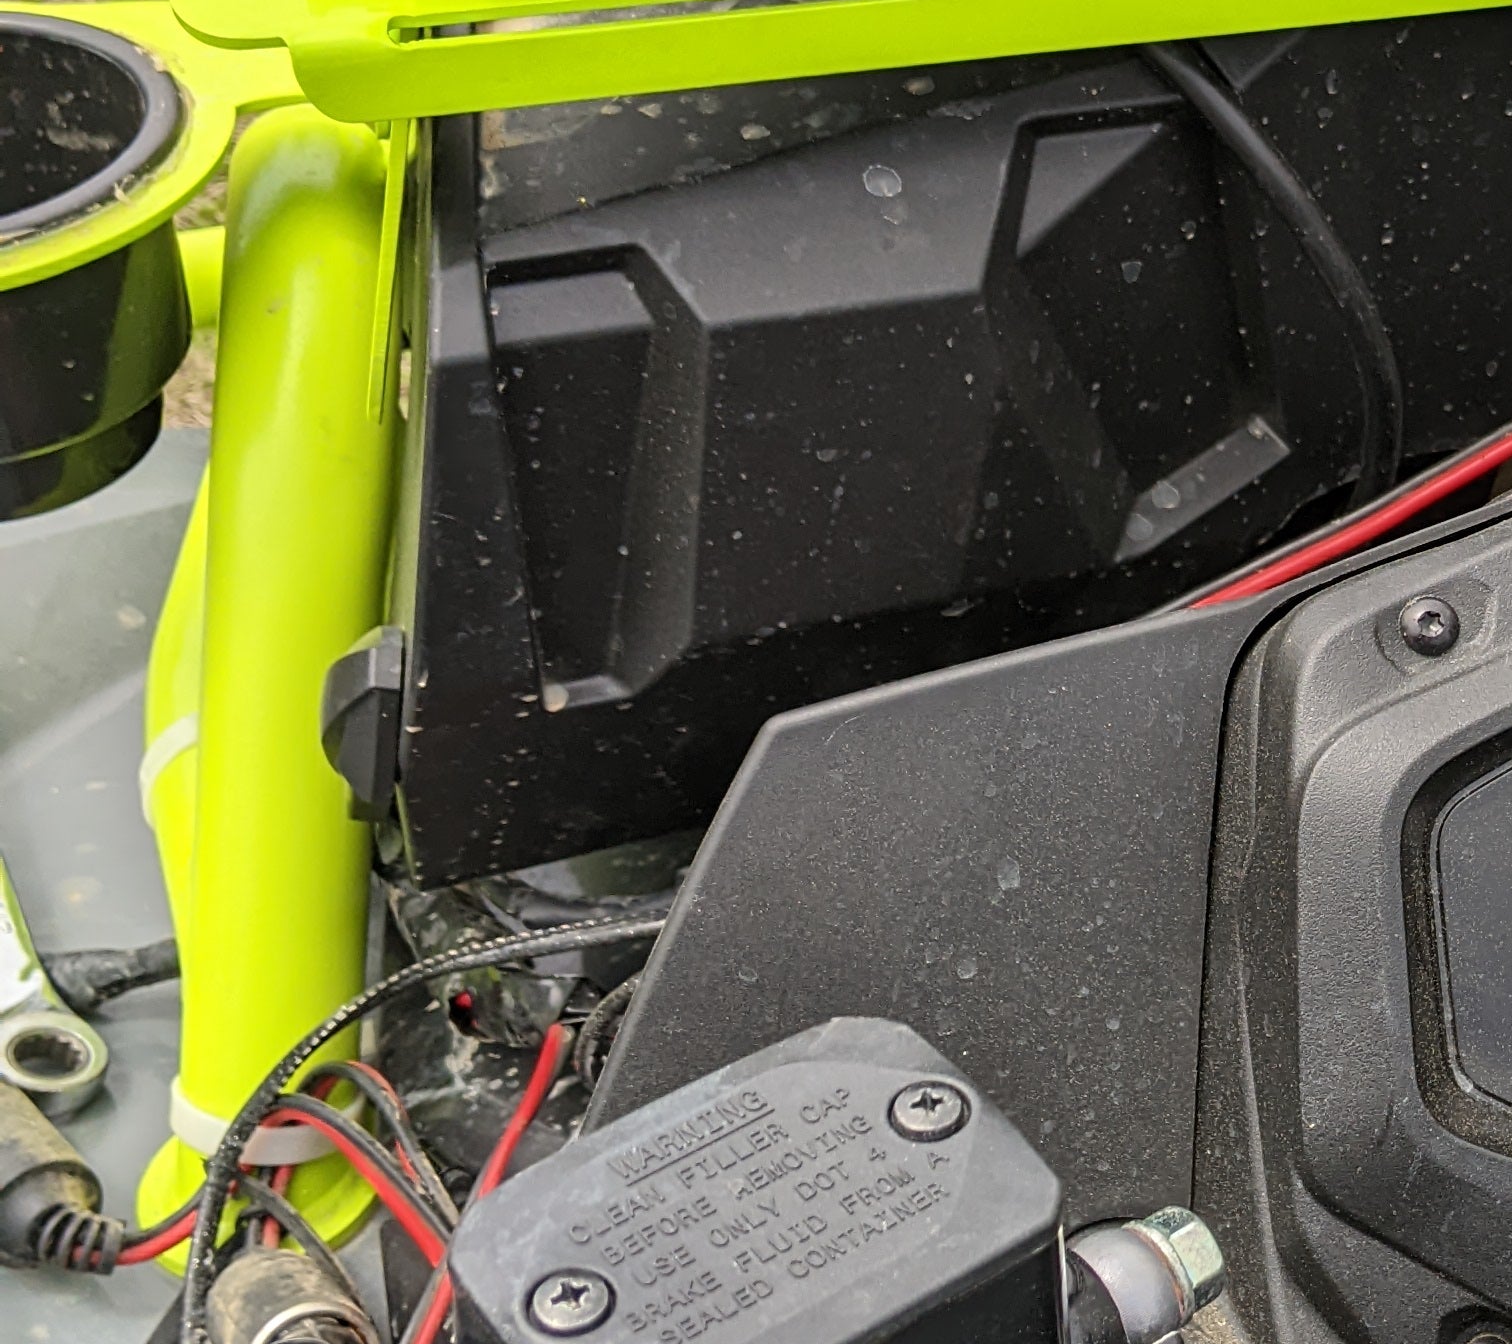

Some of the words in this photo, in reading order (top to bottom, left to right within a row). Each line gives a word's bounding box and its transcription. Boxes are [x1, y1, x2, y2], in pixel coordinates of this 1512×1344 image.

[568, 1185, 666, 1246] CLEAN
[681, 1121, 788, 1191] FILLER
[800, 1086, 853, 1128] CAP
[601, 1194, 718, 1267] BEFORE
[731, 1114, 874, 1201] REMOVING
[606, 1086, 770, 1182] WARNING
[623, 1272, 722, 1335] BRAKE
[734, 1215, 829, 1274] FLUID
[840, 1172, 917, 1219] FROM
[926, 1148, 952, 1169] A
[636, 1250, 691, 1288] USE
[710, 1204, 782, 1250] ONLY
[799, 1163, 851, 1203] DOT
[786, 1181, 953, 1281] CONTAINER
